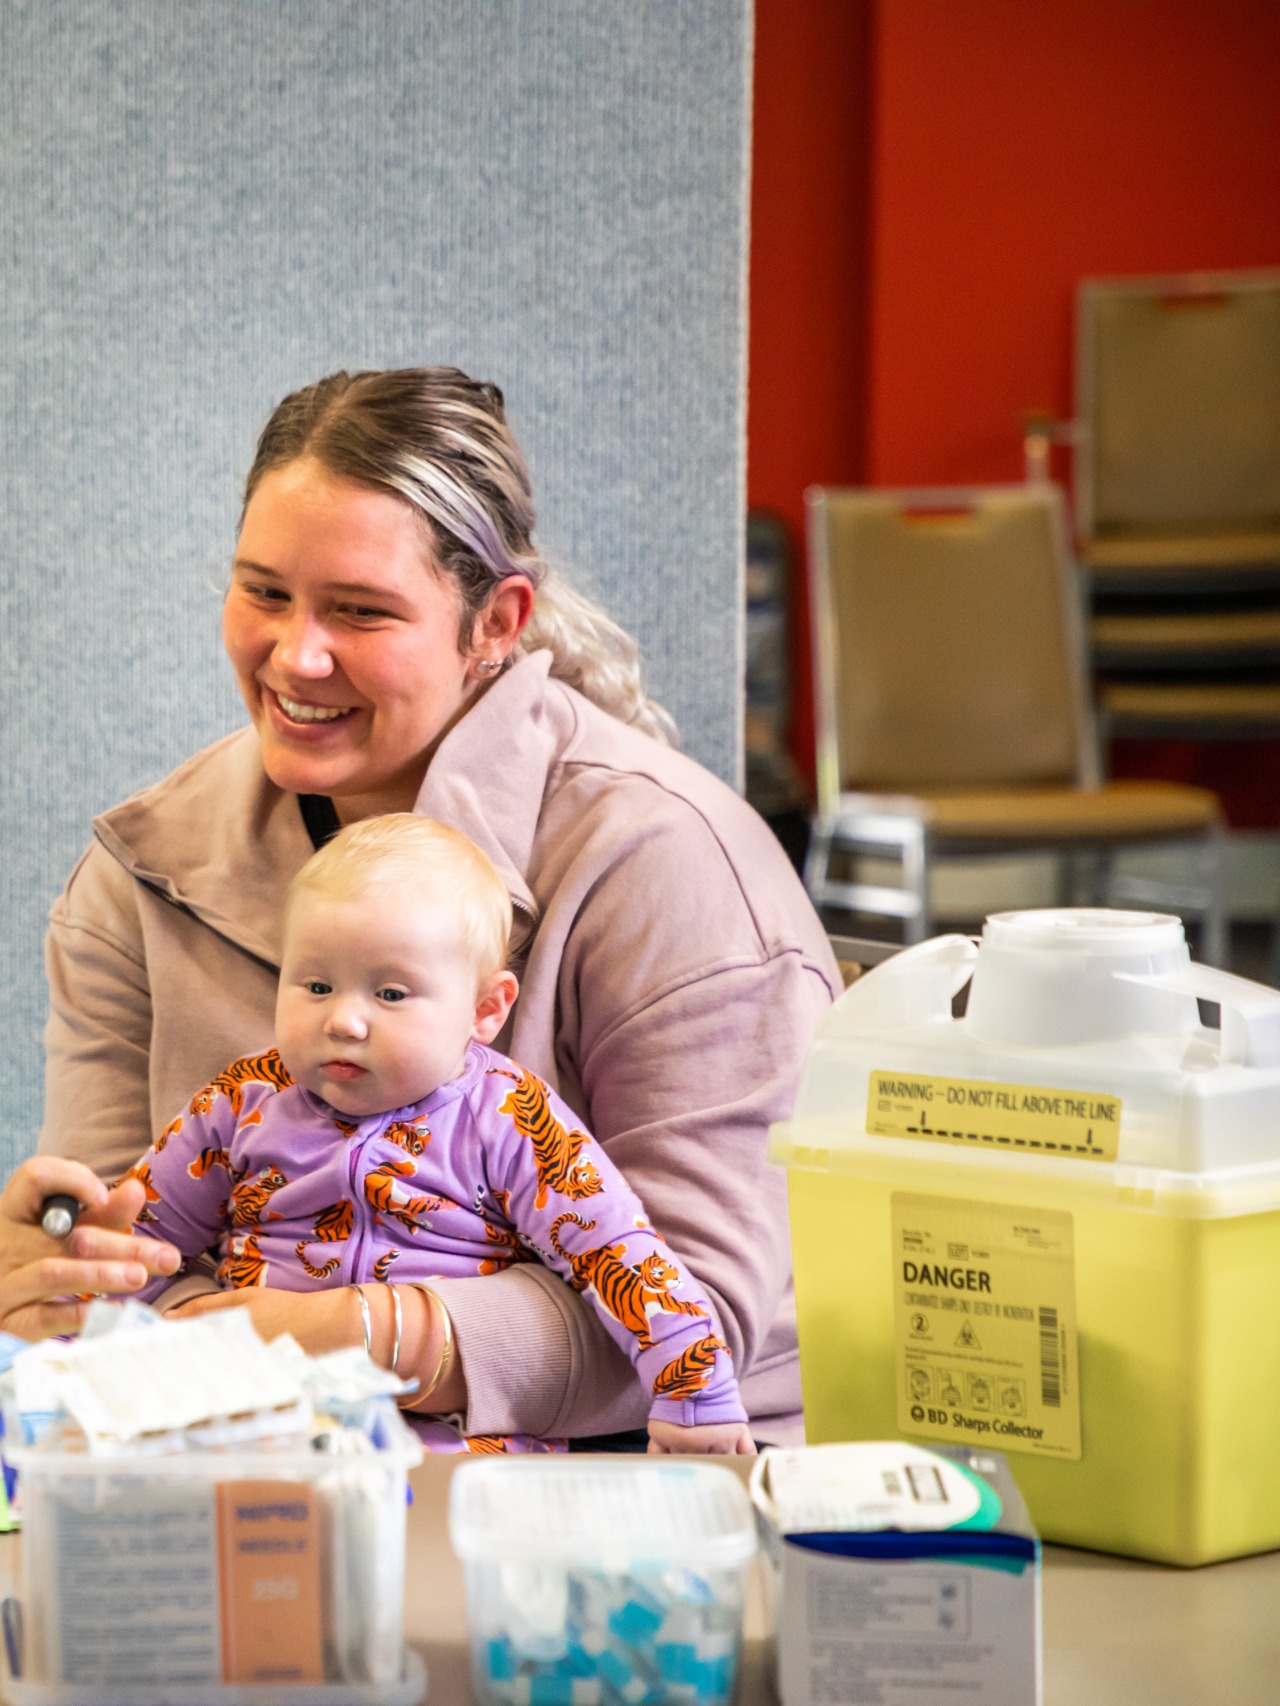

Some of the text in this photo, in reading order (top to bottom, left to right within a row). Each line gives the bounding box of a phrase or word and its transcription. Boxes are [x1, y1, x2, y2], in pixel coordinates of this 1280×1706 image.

[878, 1079, 933, 1101] WARNING
[947, 1086, 966, 1106] DO
[968, 1089, 993, 1110] NOT
[996, 1091, 1018, 1111] FILL
[1022, 1095, 1061, 1116] ABOVE
[1064, 1098, 1086, 1119] THE
[1089, 1101, 1116, 1122] LINE
[903, 1261, 992, 1294] DANGER
[928, 1404, 1044, 1440] BD Sharps Collector
